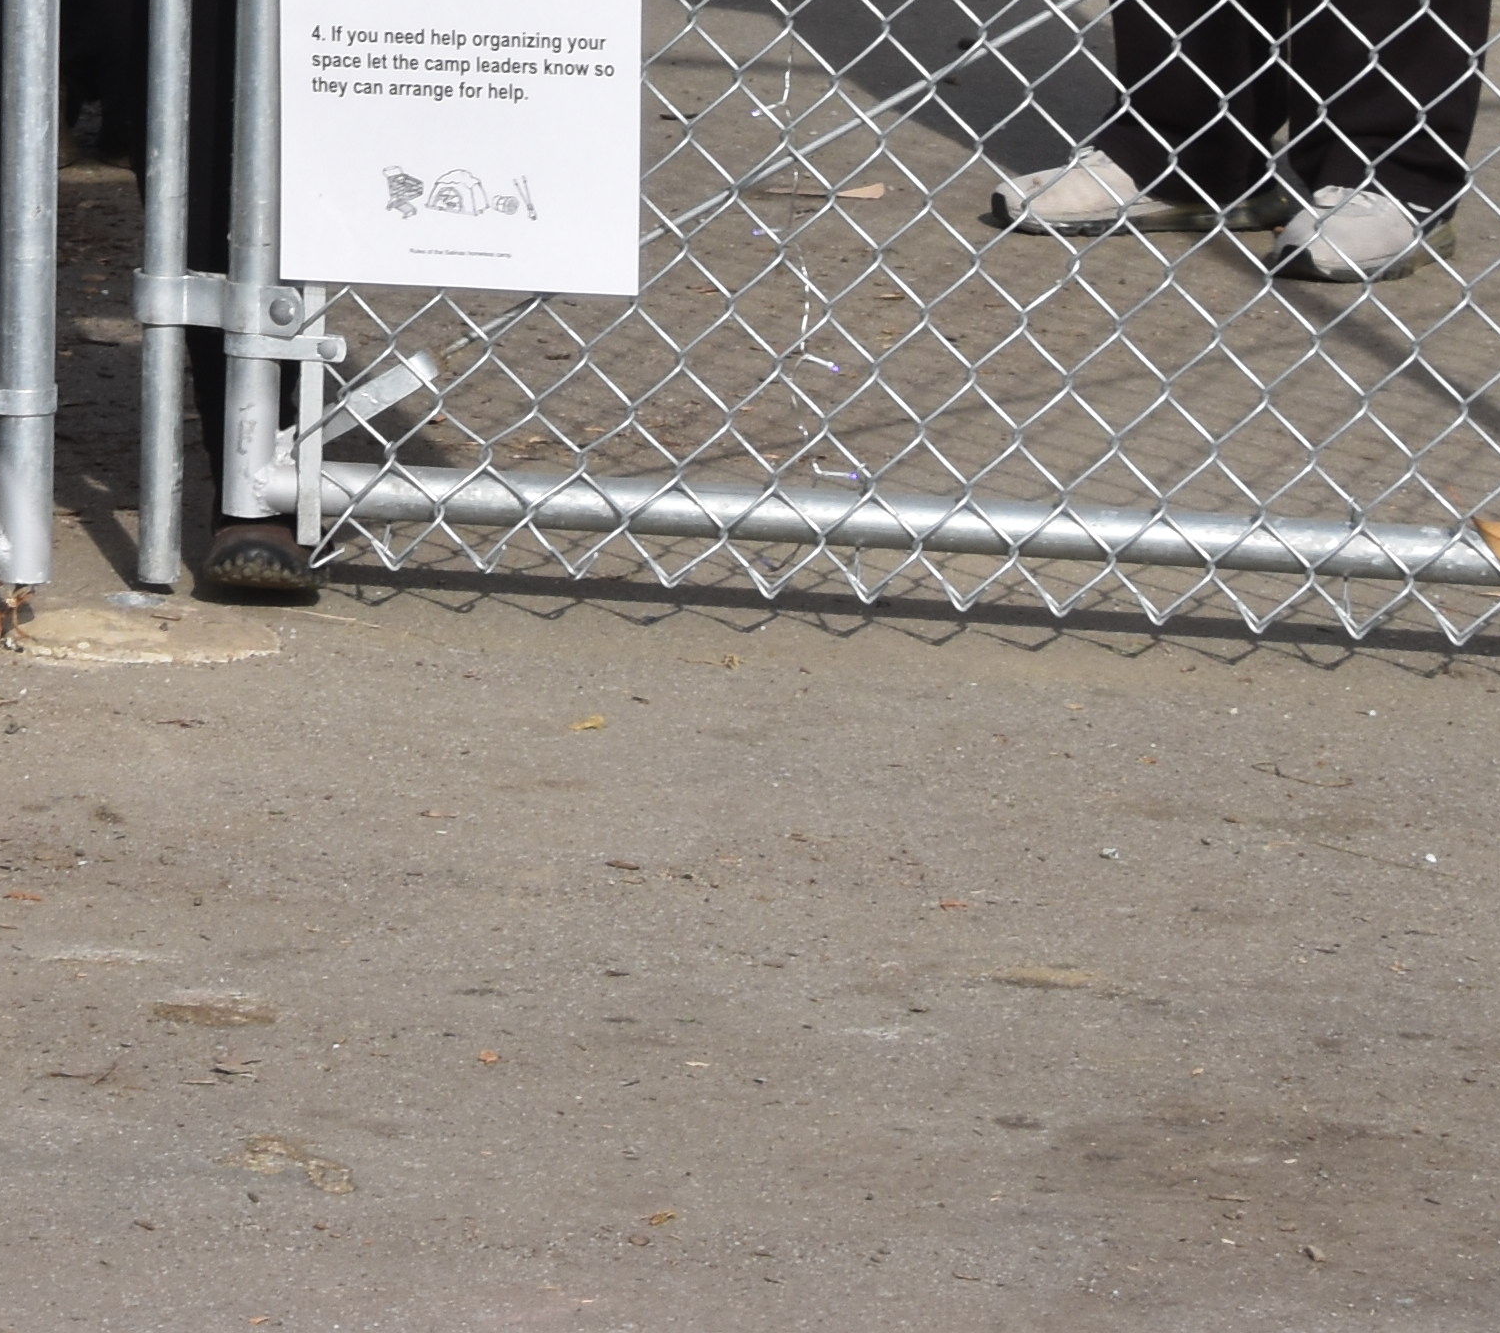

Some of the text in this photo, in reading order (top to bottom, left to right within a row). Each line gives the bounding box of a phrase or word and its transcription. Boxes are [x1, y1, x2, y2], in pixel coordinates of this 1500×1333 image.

[311, 24, 607, 54] 4. If you need help organizing your
[312, 52, 615, 77] space let the camp leaders know so
[311, 76, 529, 104] they can arrange for help.
